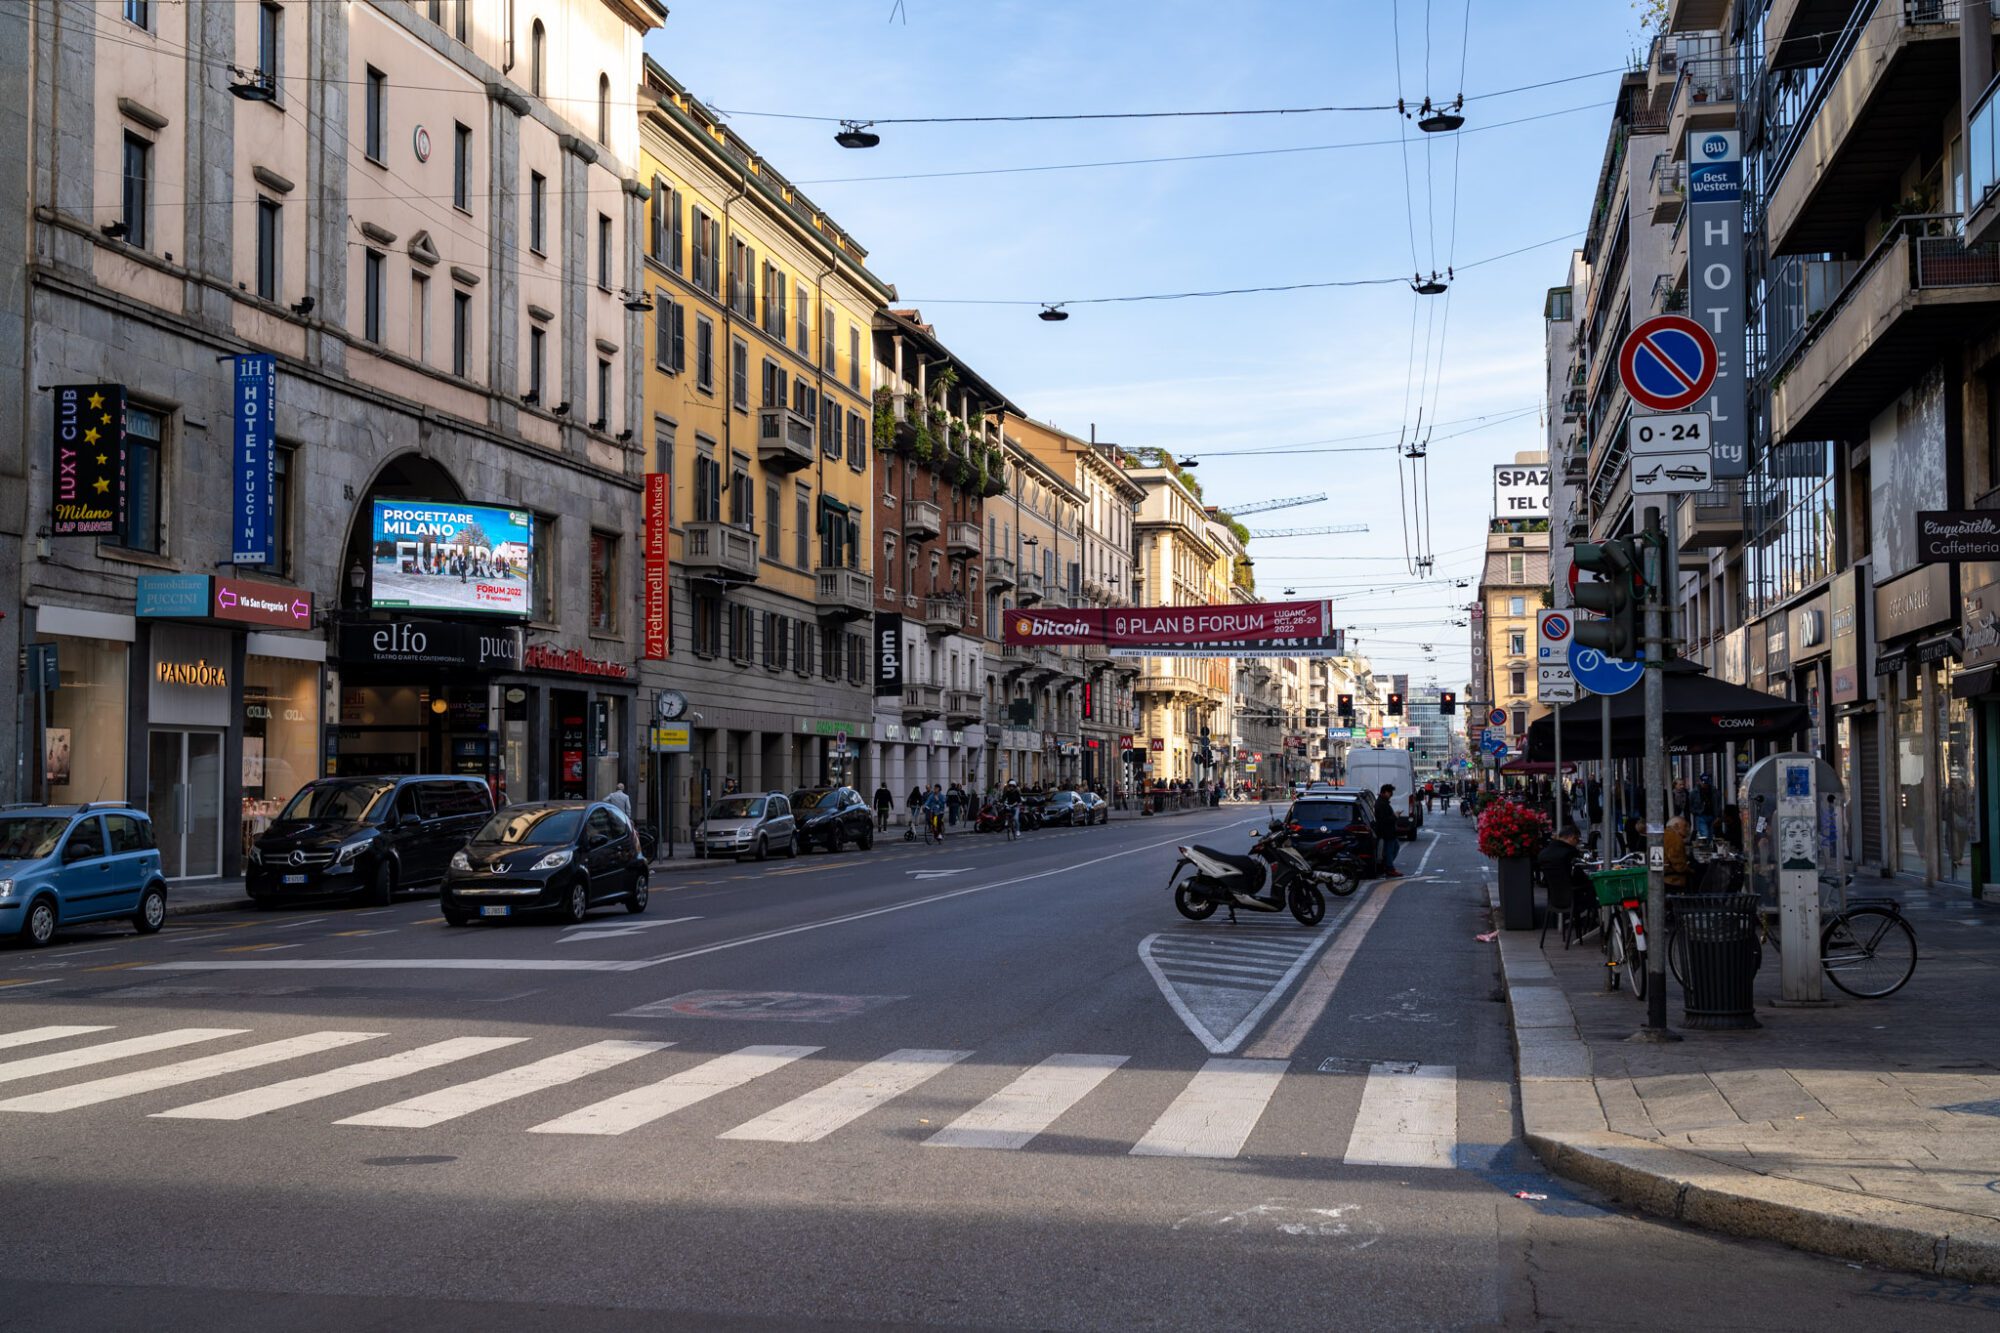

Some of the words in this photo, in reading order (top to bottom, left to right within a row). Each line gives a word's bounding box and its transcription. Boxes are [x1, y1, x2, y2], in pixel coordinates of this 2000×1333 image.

[1705, 142, 1726, 153] BW
[1703, 173, 1728, 182] Best
[1693, 182, 1737, 192] Western
[1703, 219, 1731, 422] HOTEL
[61, 389, 77, 440] CLUB
[244, 386, 257, 463] HOTEL
[1639, 426, 1654, 443] 0
[1671, 424, 1700, 441] 24
[60, 448, 76, 499] LUXY
[652, 476, 663, 518] Musica
[1507, 496, 1538, 510] TEL
[55, 503, 113, 520] Milano
[245, 470, 254, 550] PUCCINI
[383, 509, 473, 524] PROGETTARE
[55, 521, 76, 532] LAP
[78, 521, 113, 532] DANCE
[383, 522, 454, 537] MILANO
[1924, 517, 2000, 538] Cinquestelle
[652, 530, 663, 555] Libri
[1930, 541, 1999, 555] Caffetteria
[147, 593, 197, 604] PUCCINI
[476, 584, 506, 595] FORUM
[507, 587, 522, 597] 2022
[240, 596, 249, 605] Via
[250, 598, 260, 607] San
[261, 600, 283, 612] Gregorio
[648, 567, 663, 639] Feltrinelli
[1274, 609, 1307, 617] LUGANO
[1032, 619, 1090, 636] bitcoin
[1130, 617, 1179, 634] PLAN
[1199, 615, 1264, 633] FORUM
[1274, 617, 1292, 626] OCT.
[1274, 625, 1295, 633] 2022
[373, 624, 427, 652] elfo
[650, 642, 662, 657] la
[882, 630, 899, 679] upim
[160, 660, 228, 686] PANDORA
[1542, 671, 1550, 679] 0
